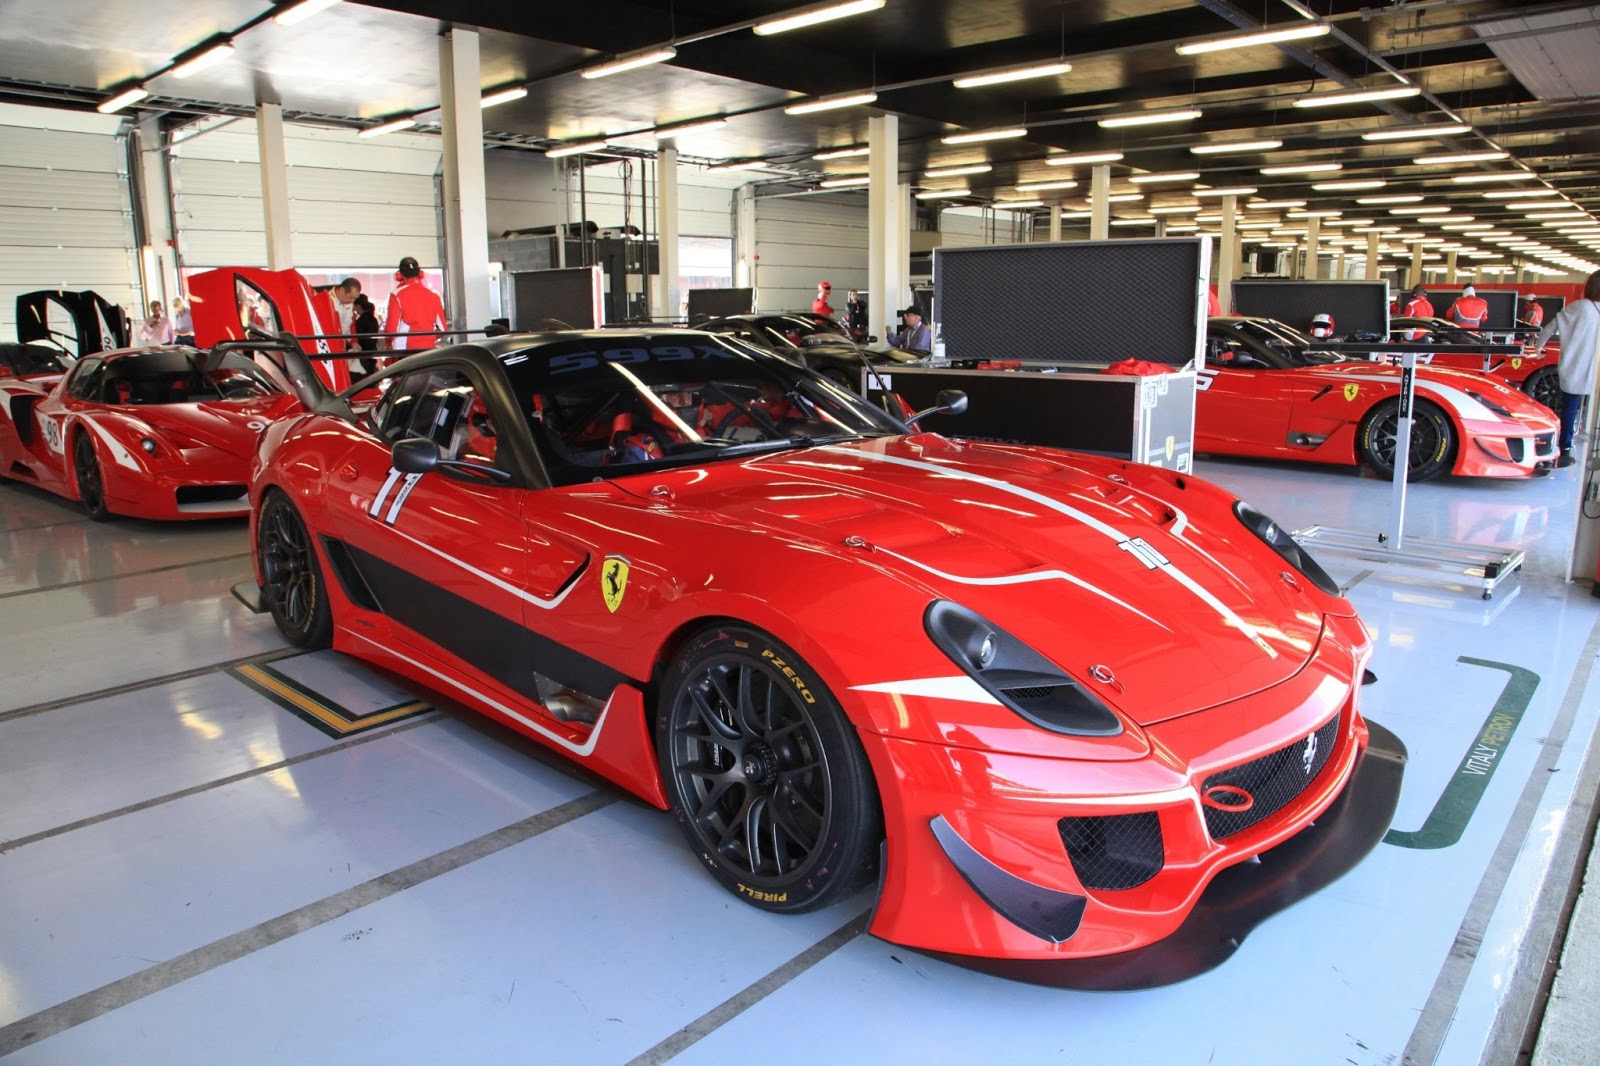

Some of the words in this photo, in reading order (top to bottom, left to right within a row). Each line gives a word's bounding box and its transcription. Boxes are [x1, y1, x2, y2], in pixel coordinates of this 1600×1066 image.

[47, 420, 58, 446] 98
[368, 465, 424, 526] 11
[1462, 743, 1499, 776] VITALY
[1481, 711, 1516, 747] PETROV
